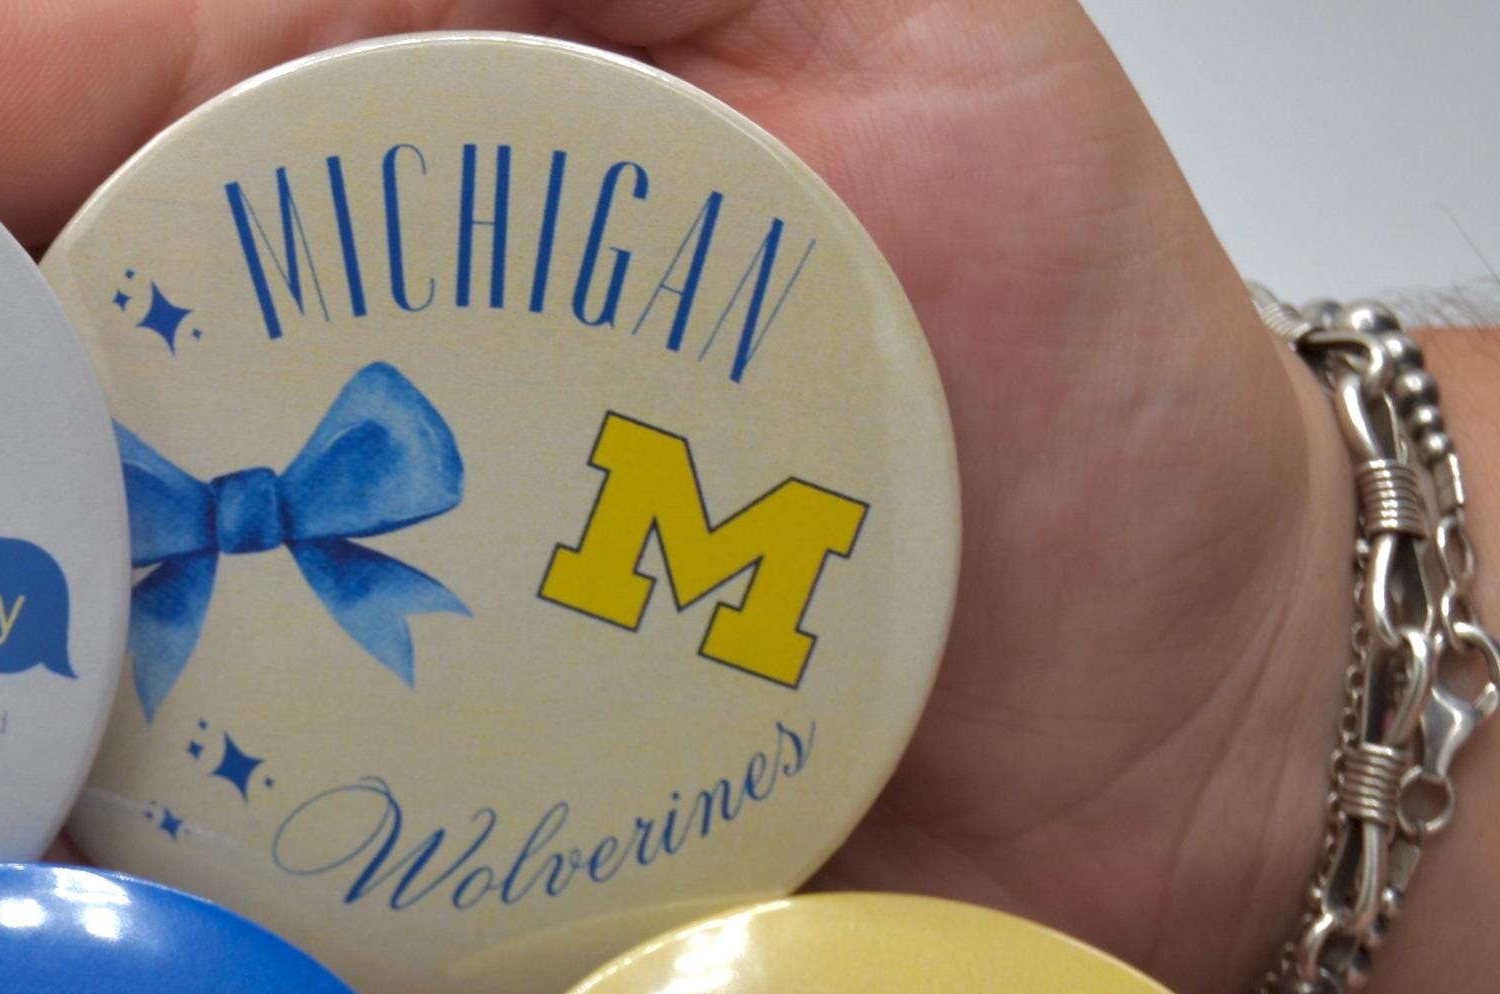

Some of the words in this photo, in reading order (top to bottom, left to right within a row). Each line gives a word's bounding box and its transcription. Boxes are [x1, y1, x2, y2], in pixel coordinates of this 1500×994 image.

[224, 143, 817, 384] MICHIGAN
[537, 410, 870, 690] M
[271, 720, 817, 911] Wolverines
